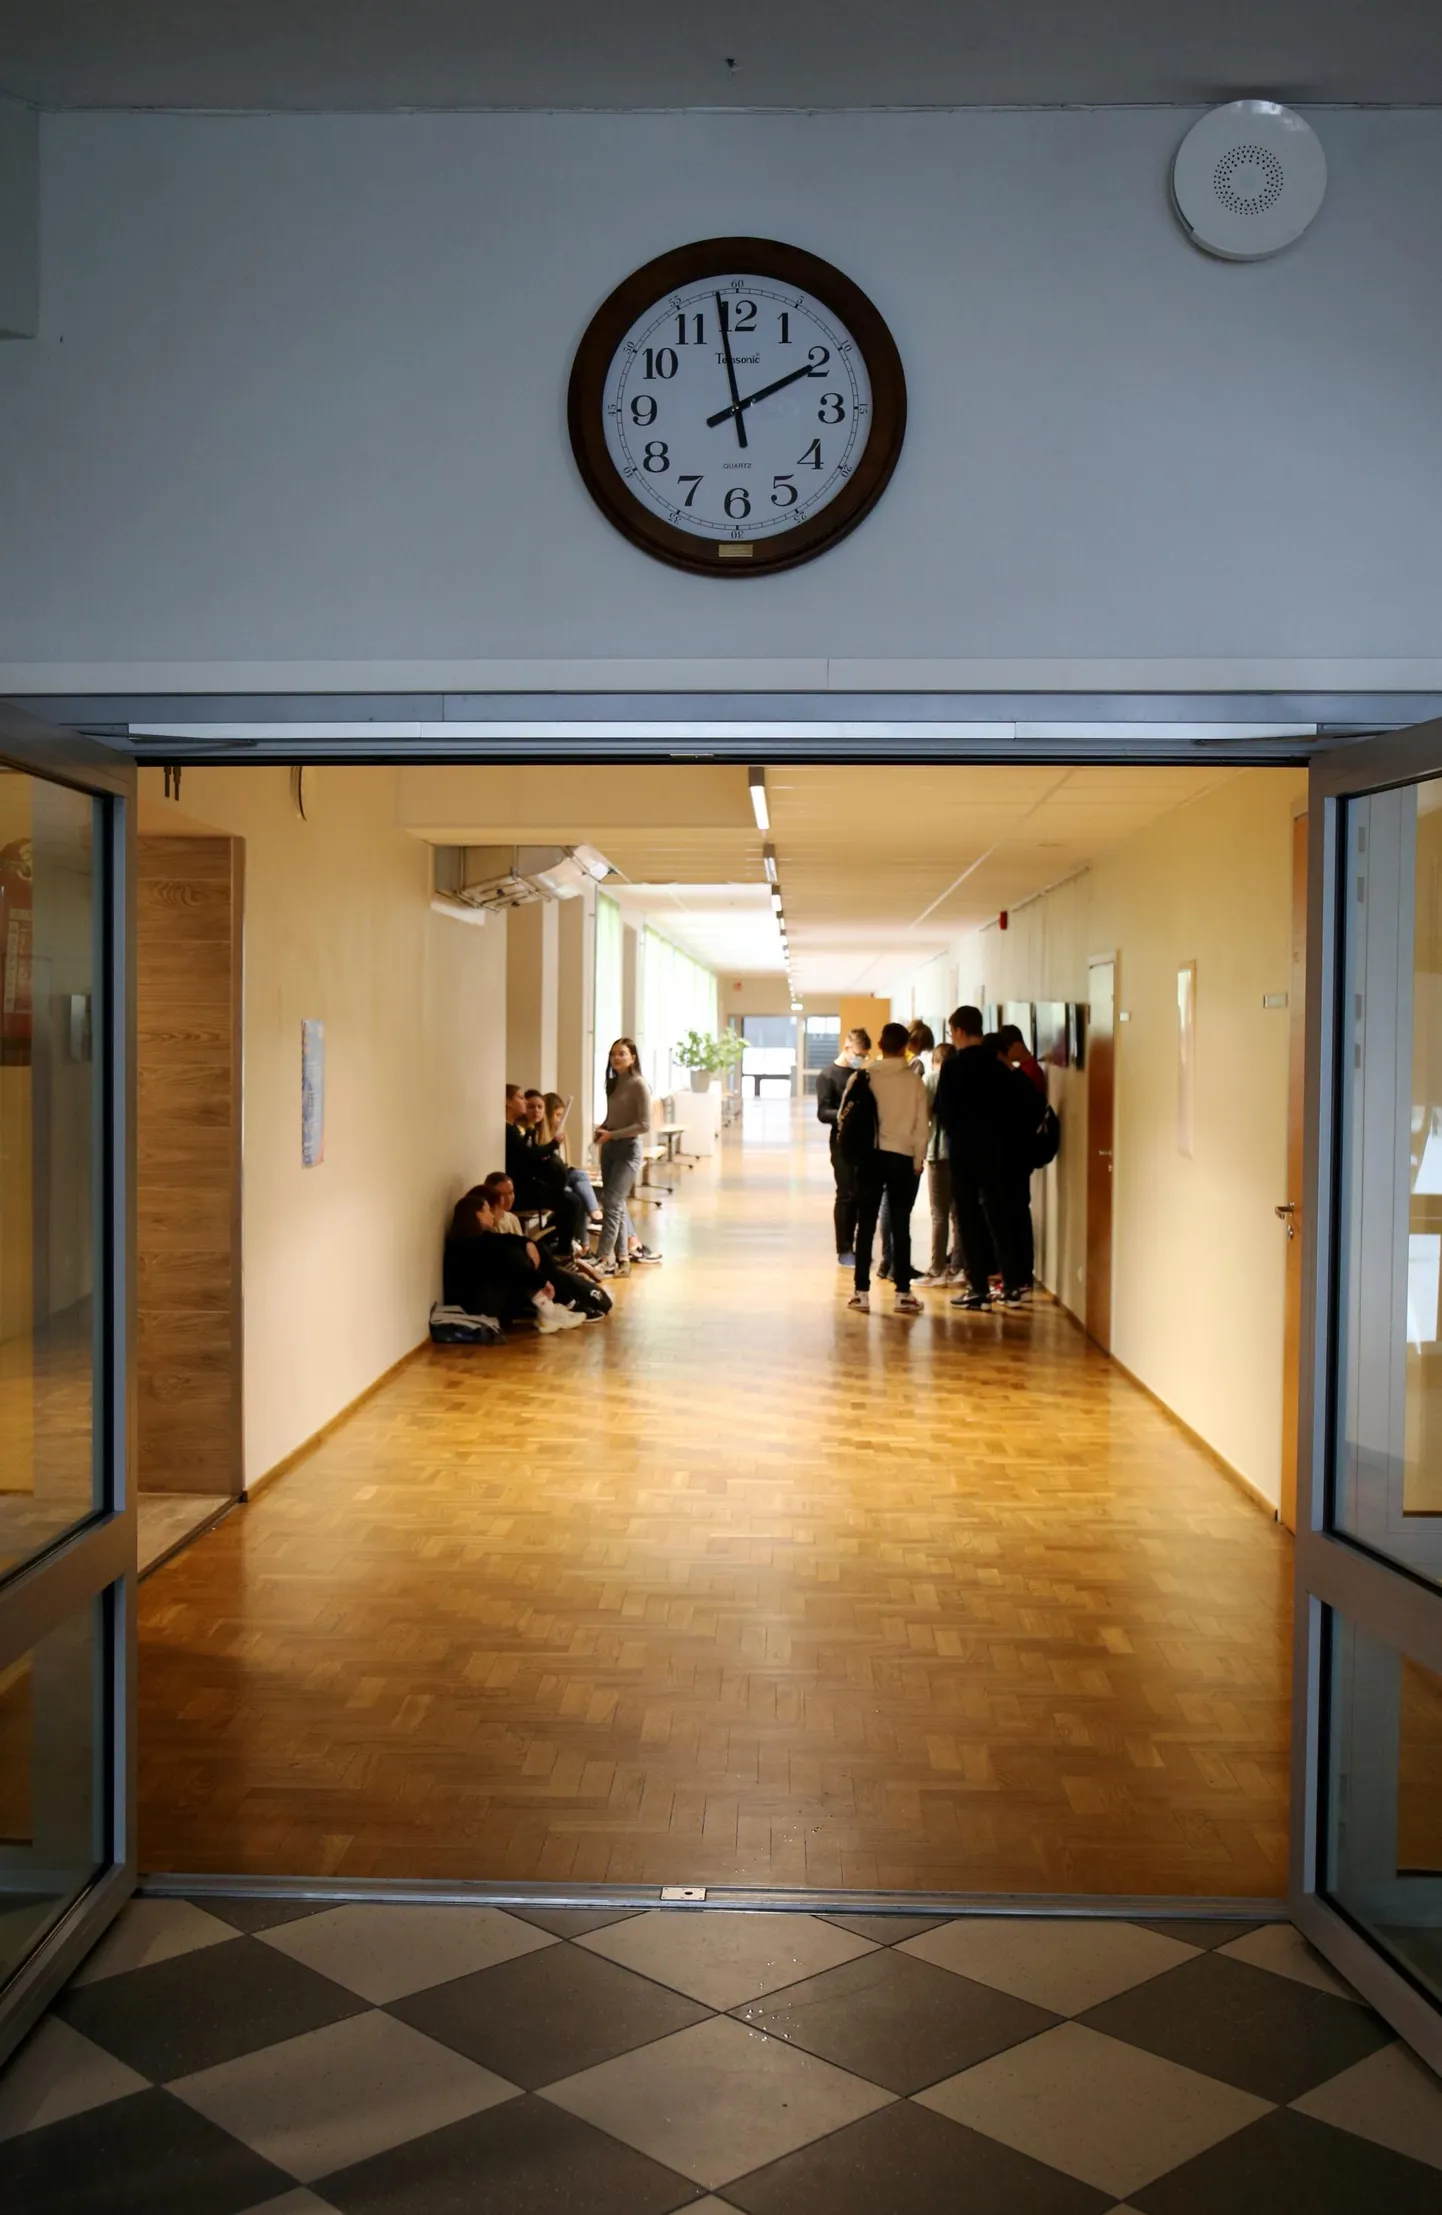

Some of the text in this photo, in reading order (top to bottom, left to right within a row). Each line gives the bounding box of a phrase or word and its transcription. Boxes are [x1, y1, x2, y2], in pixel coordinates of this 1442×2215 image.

[731, 280, 744, 288] 60
[668, 295, 682, 308] 55
[719, 300, 757, 332] 12
[675, 313, 708, 345] 11
[777, 312, 792, 344] 1
[807, 346, 830, 378] 2
[841, 340, 853, 352] 10
[642, 347, 679, 379] 10
[630, 394, 658, 427] 9
[818, 392, 846, 424] 3
[859, 403, 869, 415] 15
[643, 441, 670, 473] 8
[797, 438, 825, 470] 4
[677, 475, 704, 507] 7
[724, 487, 751, 519] 6
[771, 474, 798, 507] 5
[730, 530, 744, 539] 30
